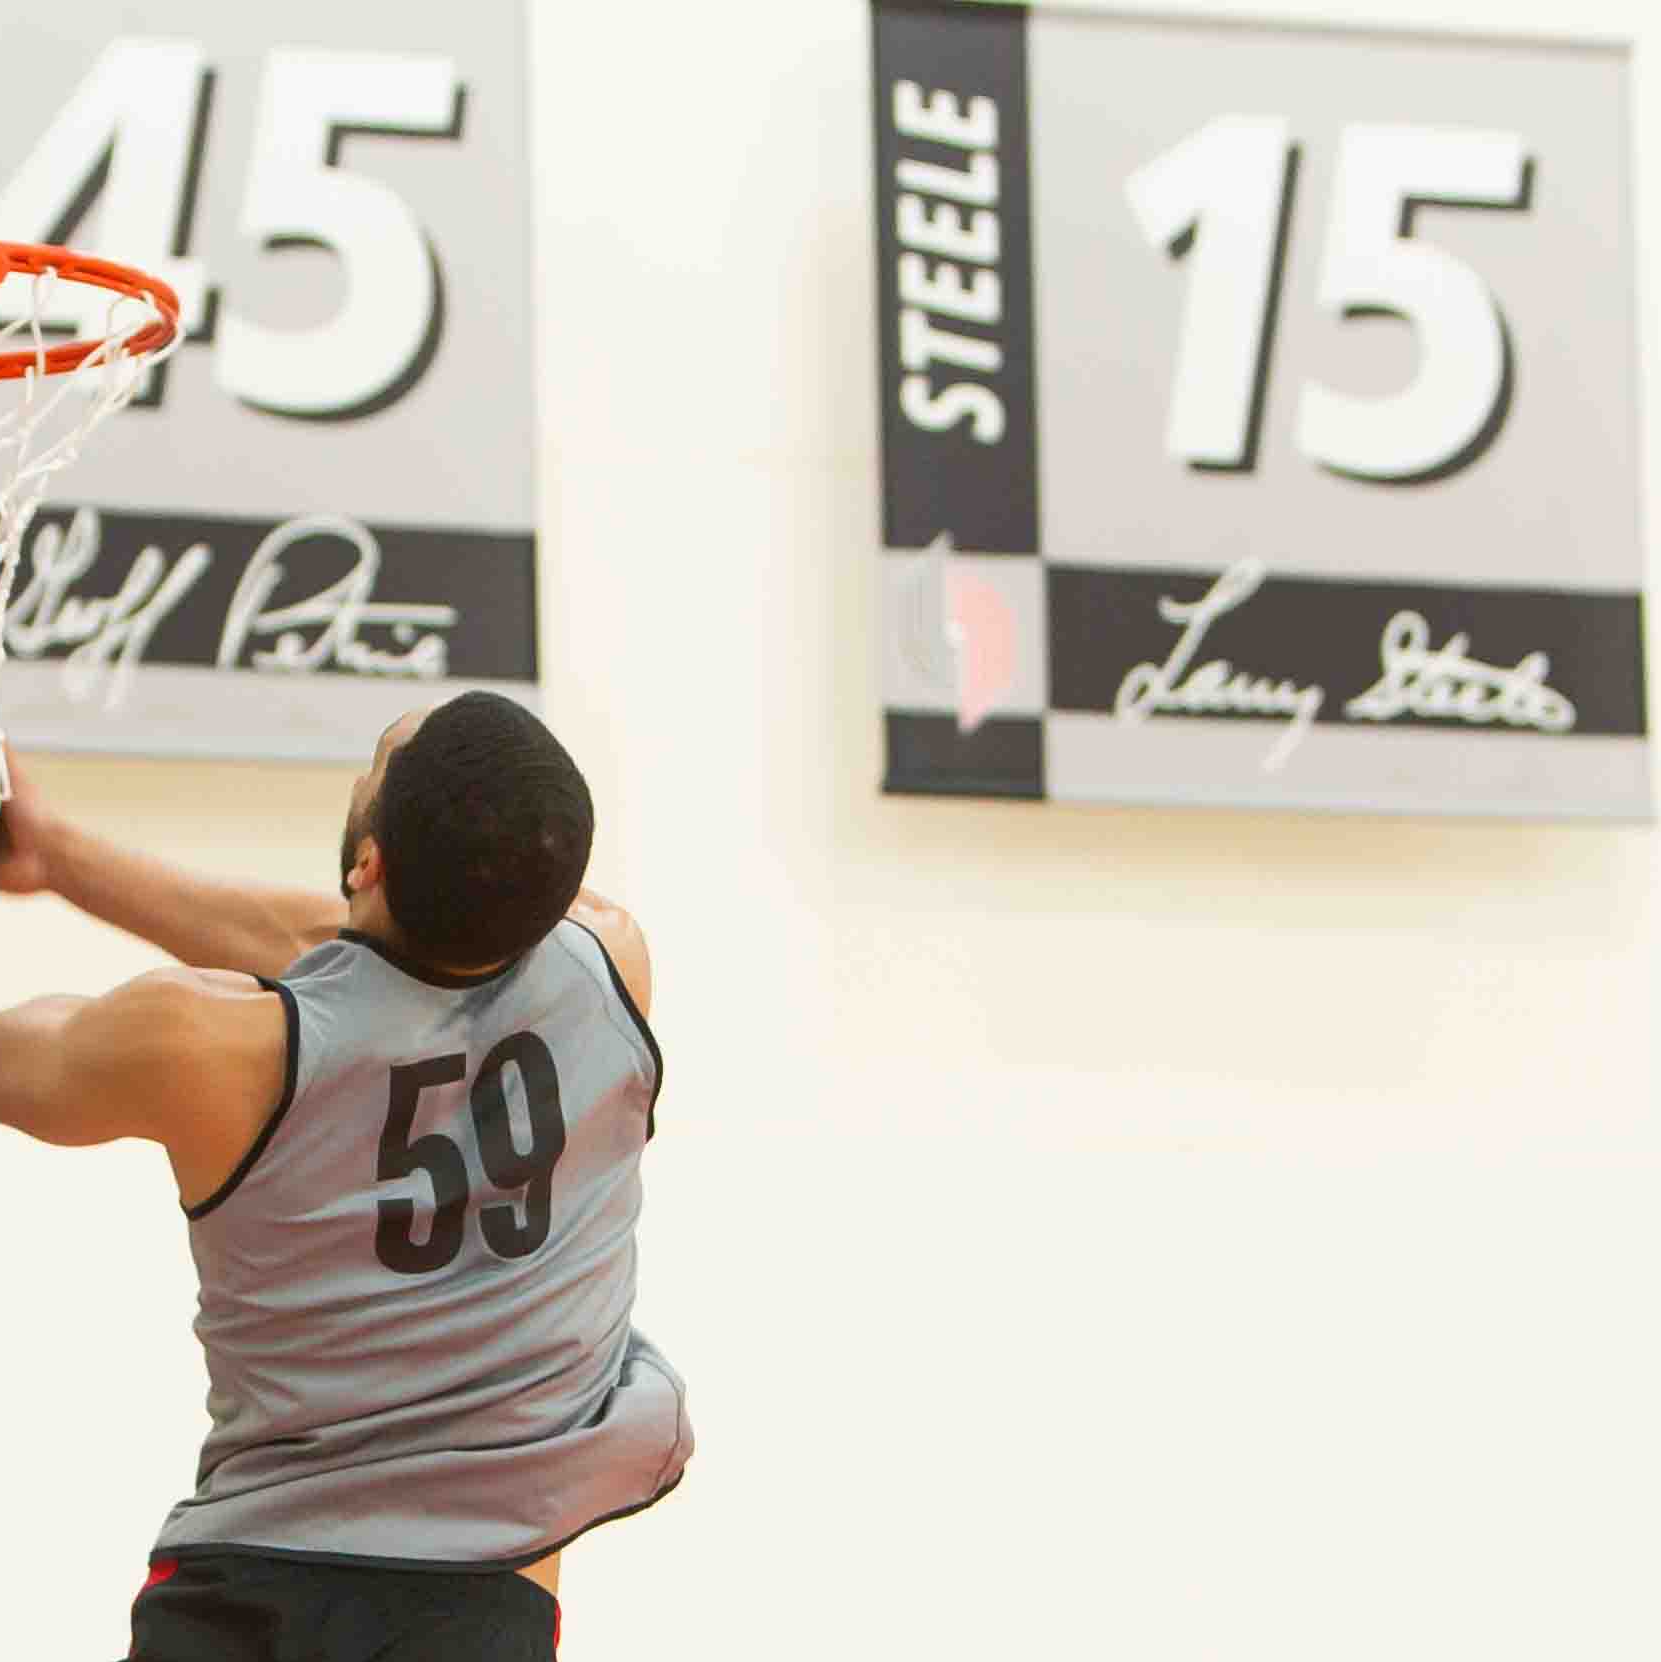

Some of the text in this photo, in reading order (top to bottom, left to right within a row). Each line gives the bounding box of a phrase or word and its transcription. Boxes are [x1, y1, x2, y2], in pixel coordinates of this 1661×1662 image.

[893, 79, 1007, 445] STEELE
[1123, 112, 1535, 488] 15
[375, 1031, 566, 1274] 59
